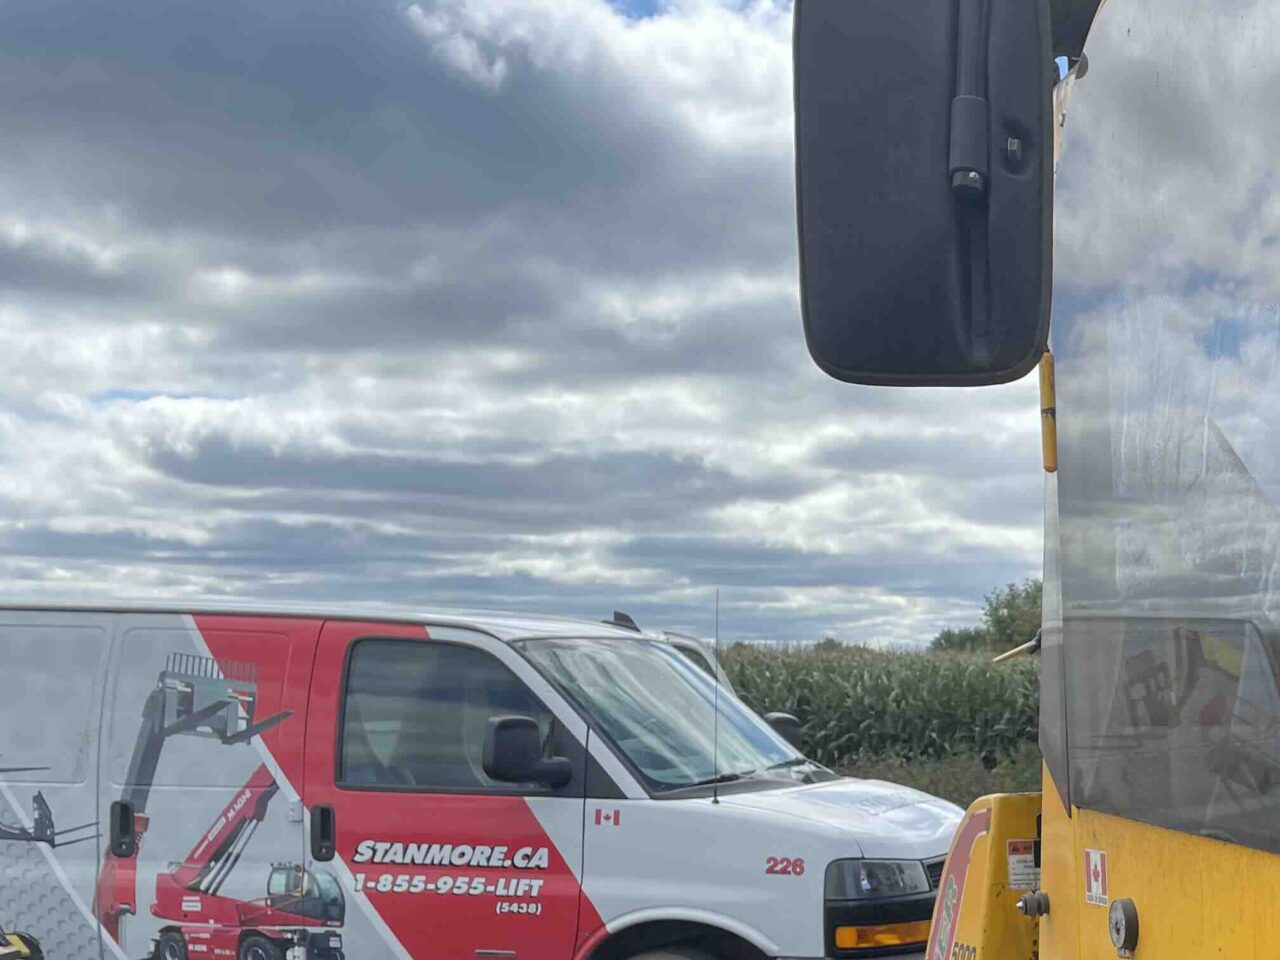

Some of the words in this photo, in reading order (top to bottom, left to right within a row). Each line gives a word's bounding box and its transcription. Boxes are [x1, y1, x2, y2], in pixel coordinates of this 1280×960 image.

[353, 840, 549, 869] STANMORE.CA
[765, 856, 805, 876] 226
[353, 873, 544, 898] 1-855-955-LIFT
[495, 902, 542, 916] (5438)
